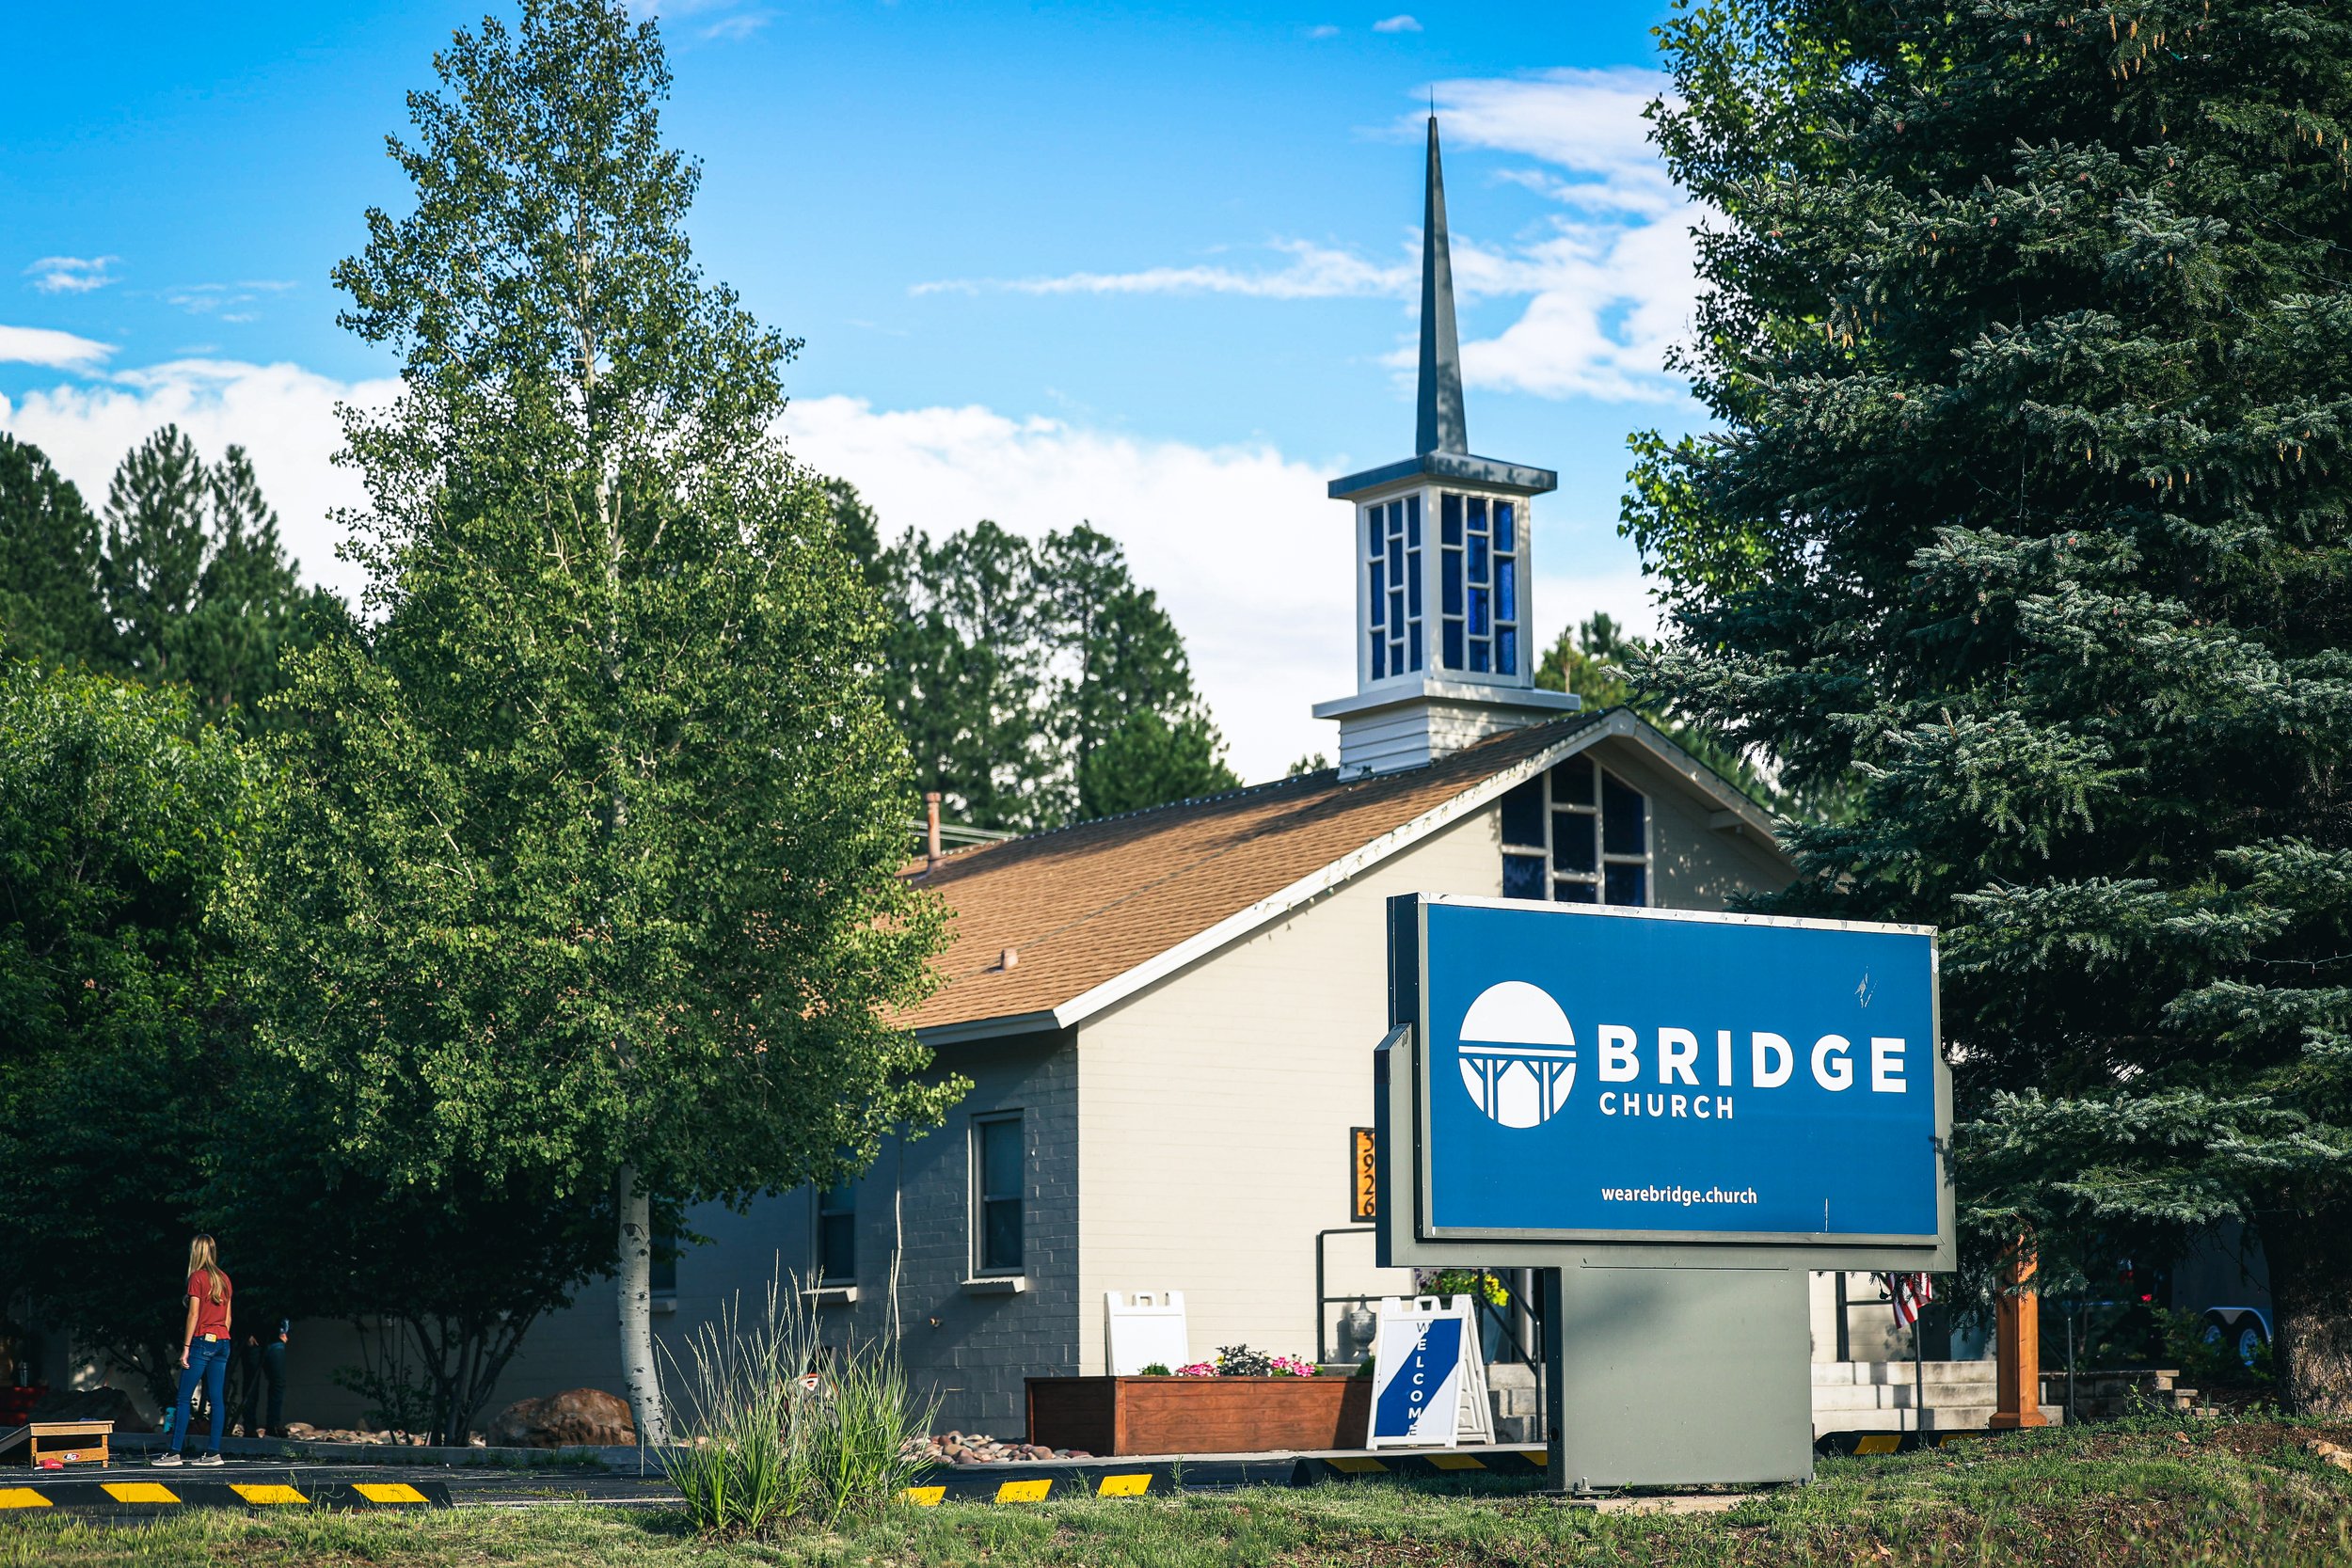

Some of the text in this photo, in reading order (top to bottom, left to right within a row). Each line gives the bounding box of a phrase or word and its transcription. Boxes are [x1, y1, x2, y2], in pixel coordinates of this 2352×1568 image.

[1597, 1023, 1907, 1093] BRIDGE
[1598, 1091, 1733, 1119] CHURCH
[1362, 1131, 1375, 1216] 3926
[1601, 1185, 1757, 1207] wearebridge.church
[1407, 1323, 1431, 1435] WELCOME
